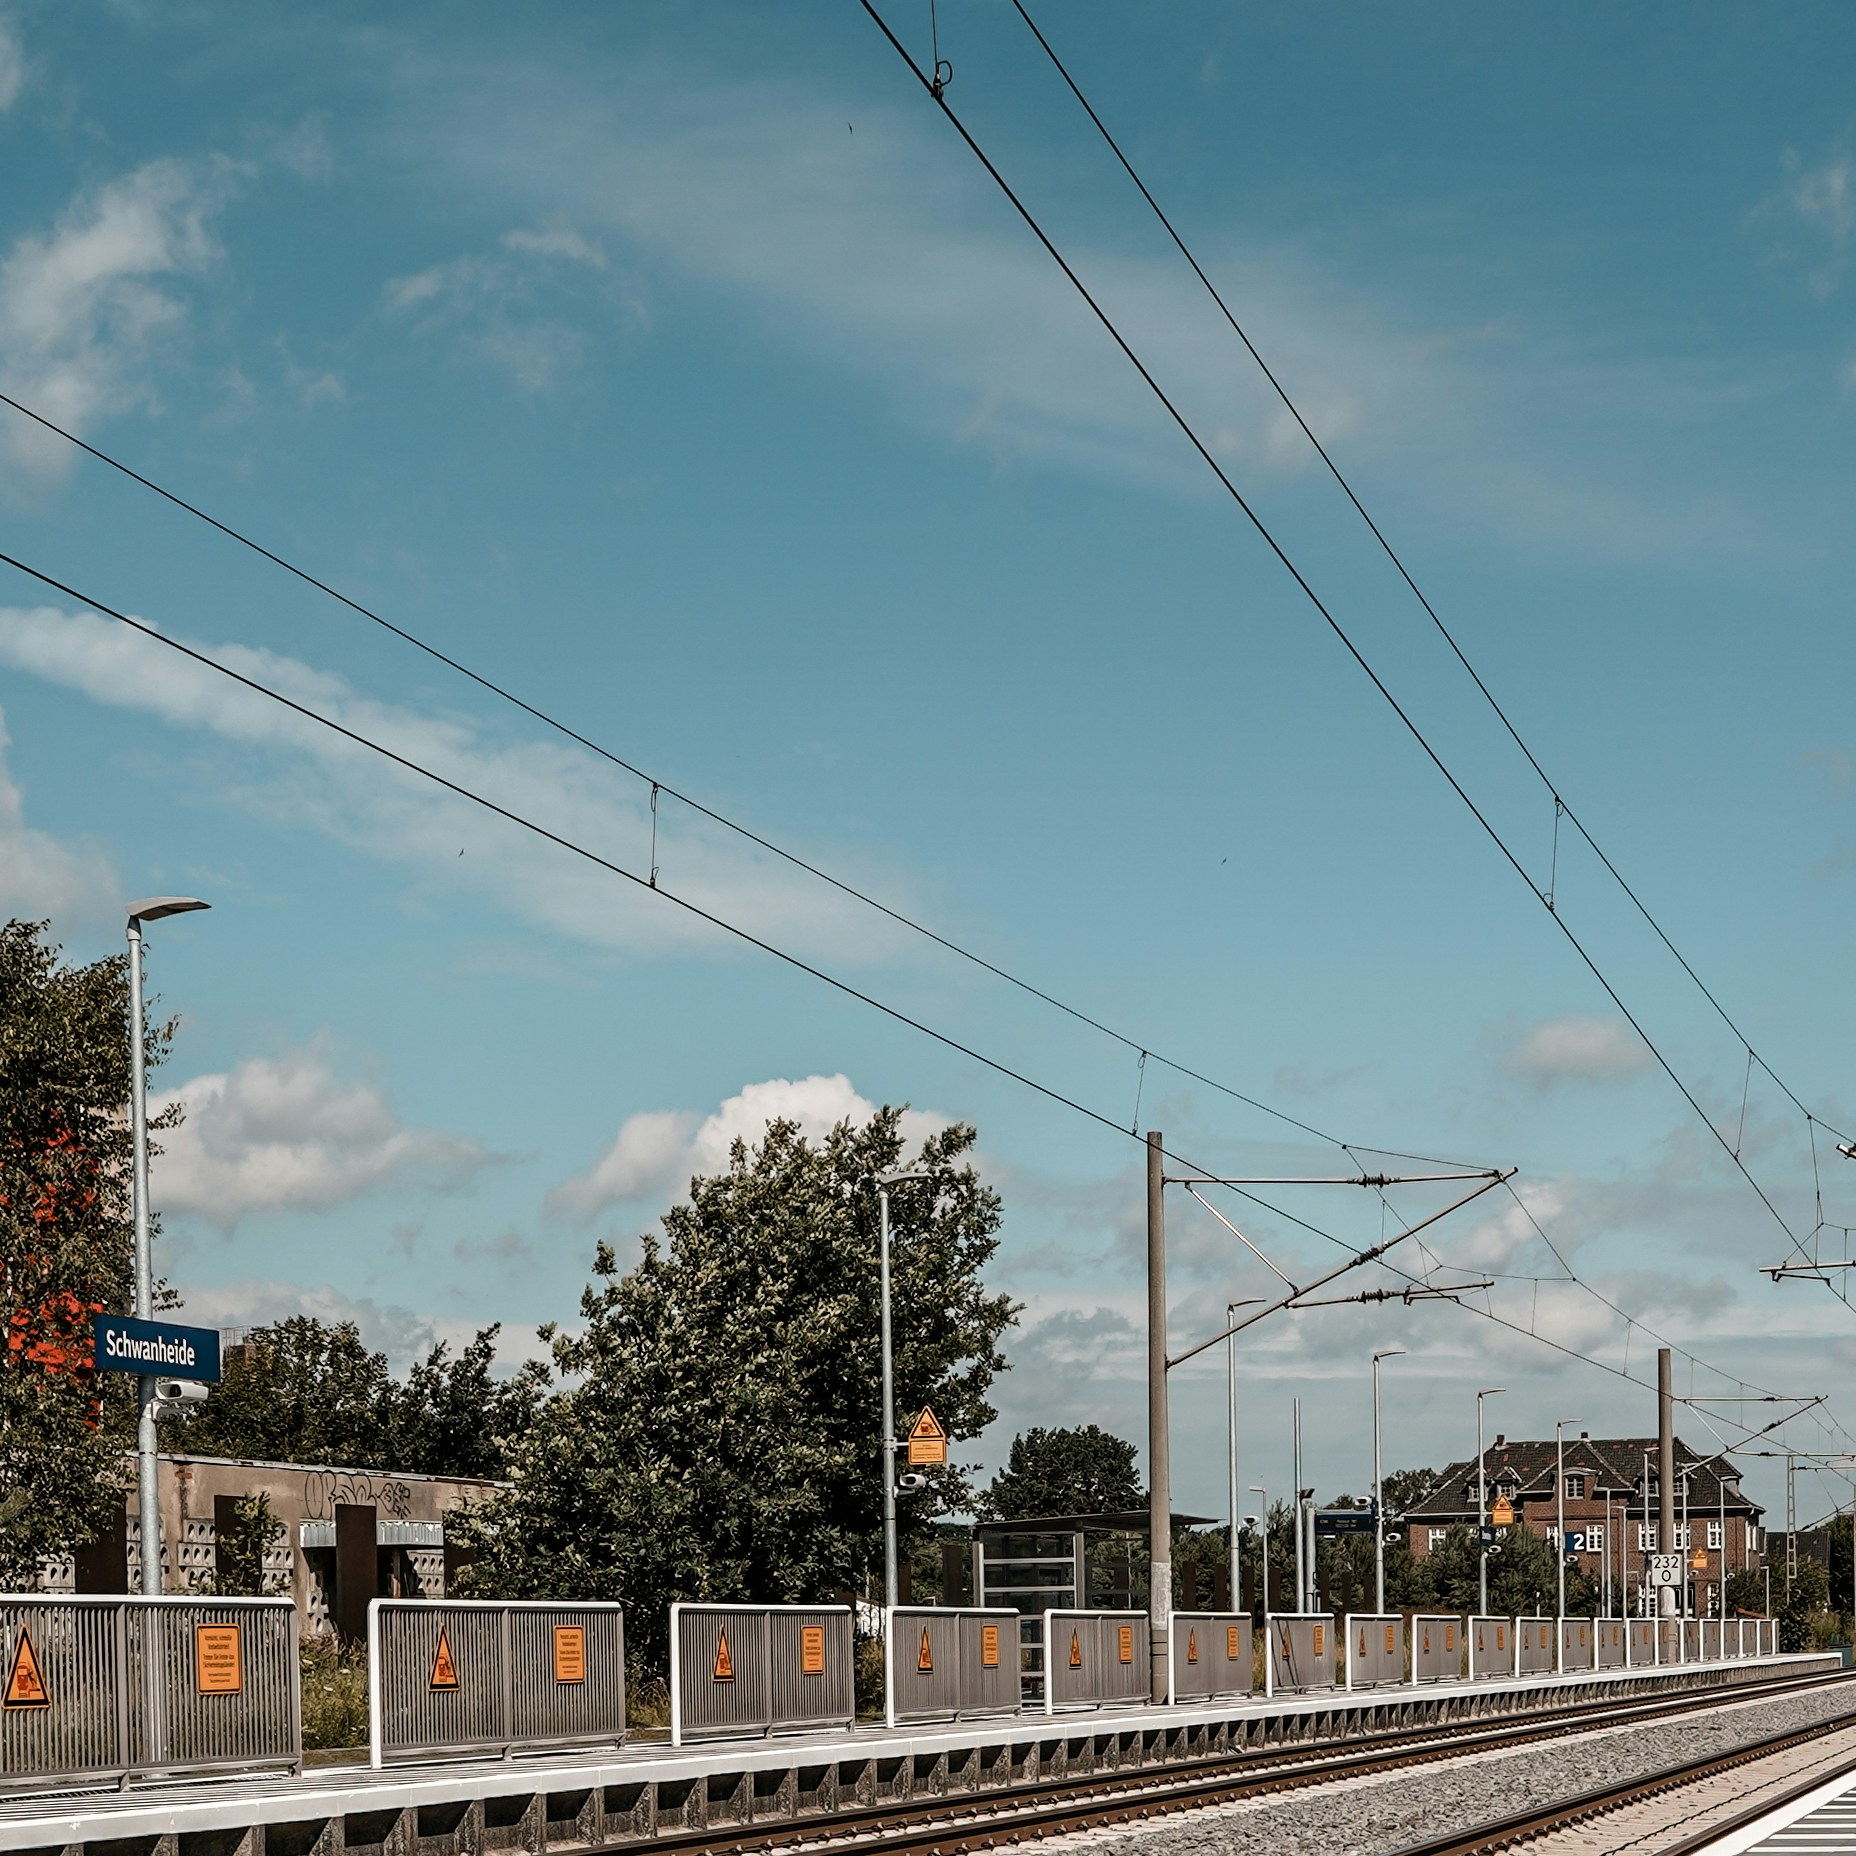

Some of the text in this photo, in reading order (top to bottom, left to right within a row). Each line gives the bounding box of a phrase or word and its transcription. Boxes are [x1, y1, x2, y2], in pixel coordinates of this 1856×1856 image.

[106, 1329, 195, 1366] Schwanheide
[1573, 1533, 1585, 1550] 2
[1653, 1555, 1679, 1569] 232
[1661, 1569, 1671, 1582] 0
